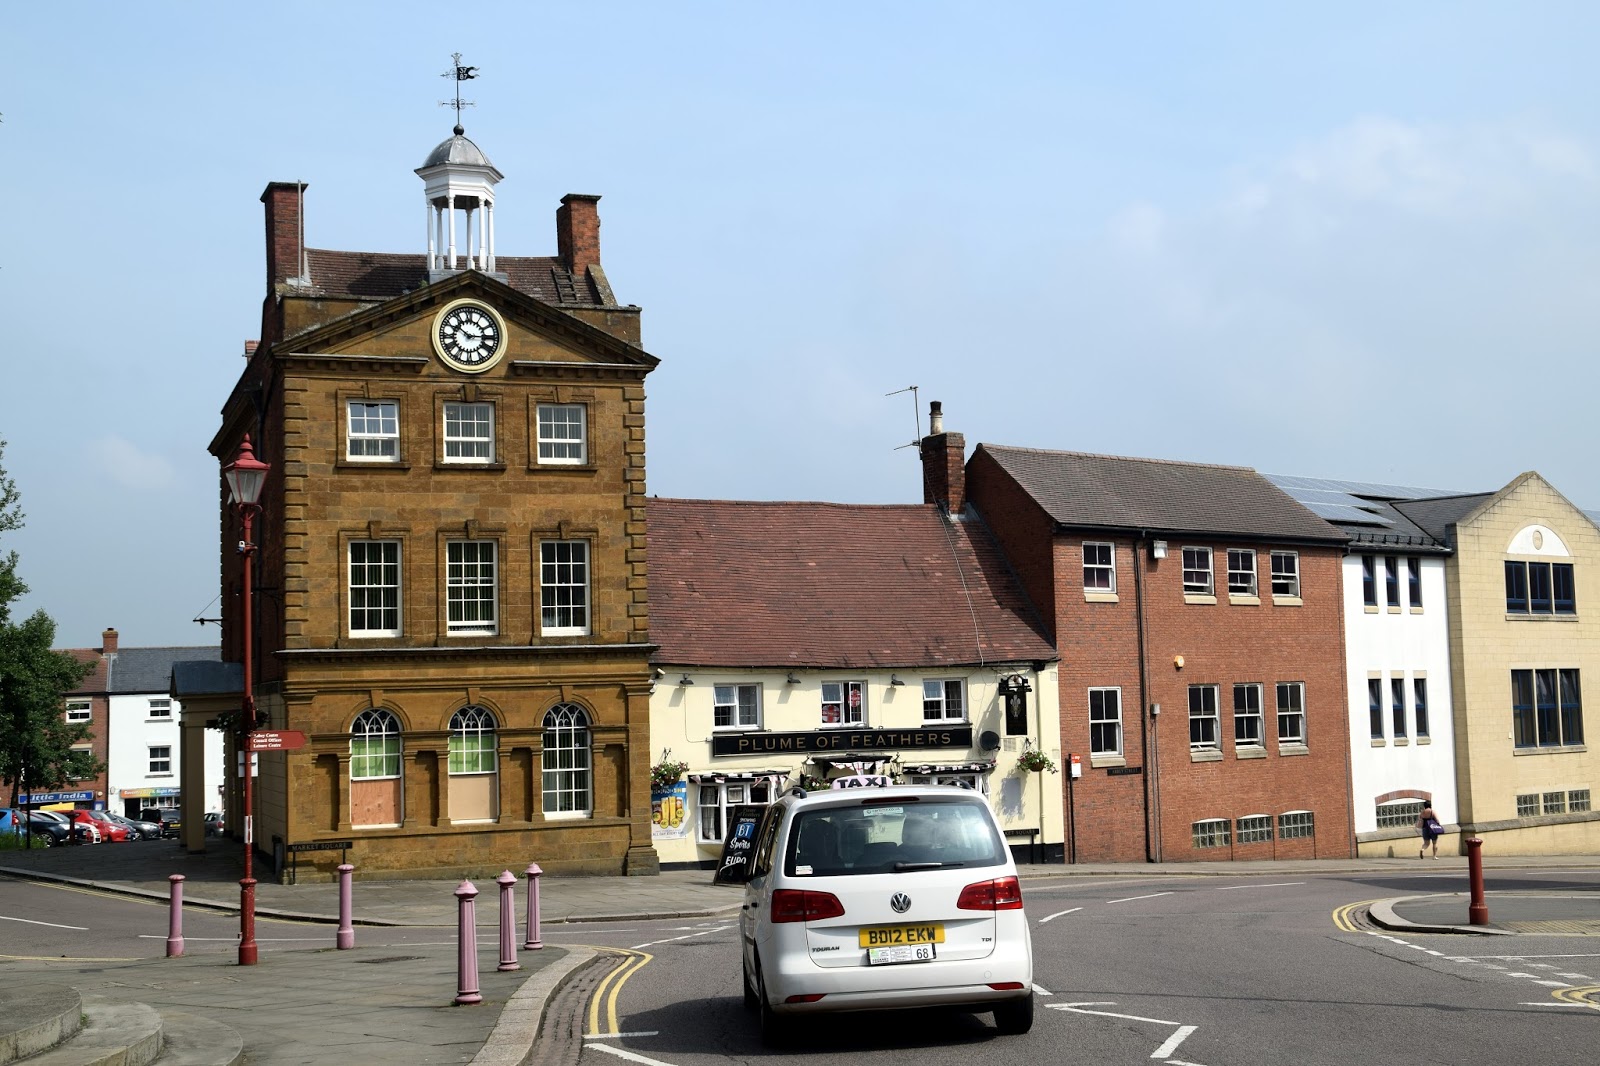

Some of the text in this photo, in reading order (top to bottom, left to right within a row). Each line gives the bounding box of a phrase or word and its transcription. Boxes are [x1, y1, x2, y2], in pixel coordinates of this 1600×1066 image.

[738, 733, 951, 751] PLUME OF FEATHERS
[837, 776, 888, 789] TAXI
[738, 824, 751, 837] BT
[320, 842, 346, 850] SQUARE
[730, 837, 750, 850] Sports
[868, 926, 936, 944] BD12 EKW
[916, 948, 929, 959] 68
